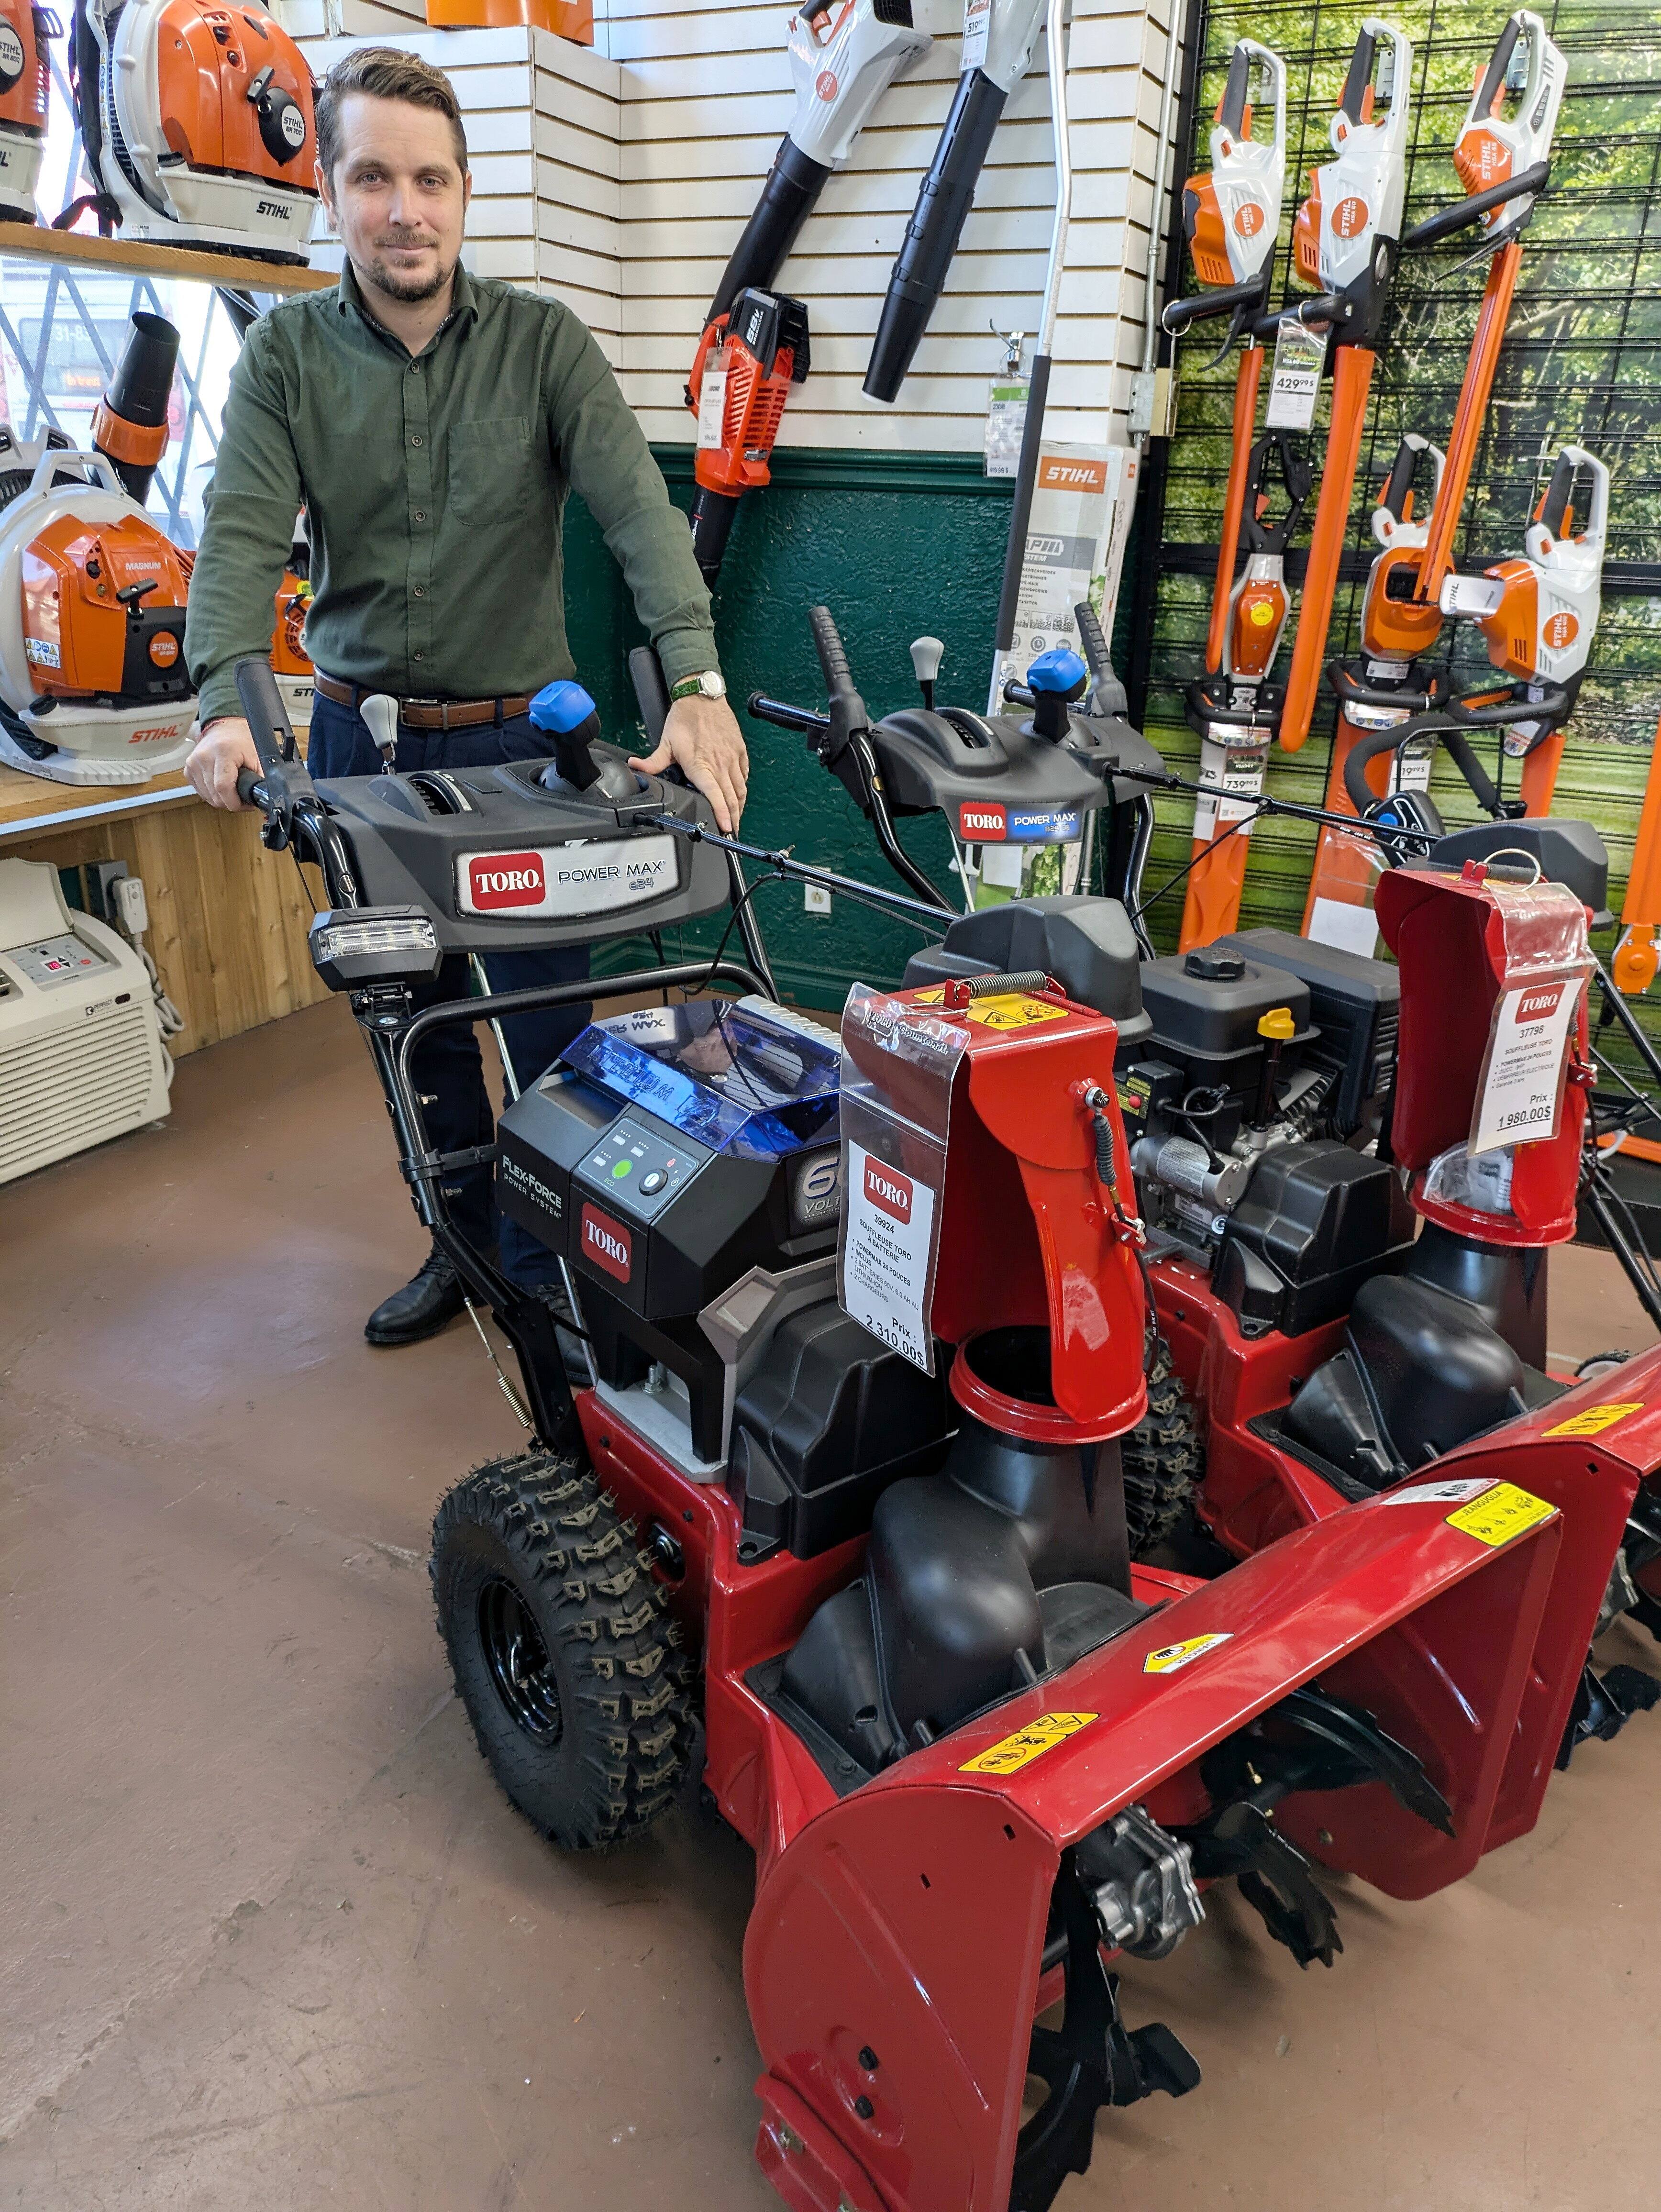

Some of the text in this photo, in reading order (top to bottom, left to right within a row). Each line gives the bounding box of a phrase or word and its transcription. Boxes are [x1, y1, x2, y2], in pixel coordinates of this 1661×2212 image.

[283, 116, 302, 129] STIHL
[1481, 140, 1491, 180] STIHL
[256, 201, 290, 220] STIHL
[1241, 207, 1252, 235] STIHL
[1341, 200, 1351, 236] STIHL
[1046, 466, 1099, 484] STIHL
[125, 562, 161, 570] MAGNUM
[1449, 583, 1460, 608] TIHL
[1553, 615, 1562, 647] STIHL
[152, 642, 175, 651] STIHL
[293, 688, 314, 697] STI
[128, 725, 179, 743] STIHL
[964, 814, 1003, 829] TORO
[1014, 813, 1075, 826] POWER MAX
[476, 869, 540, 894] TORO
[558, 861, 664, 884] POWER MAX
[629, 877, 654, 891] e24
[1521, 993, 1558, 1013] TORO
[1519, 1025, 1544, 1039] 37798
[1505, 1038, 1553, 1055] SOUFFLEUSE TORO
[587, 1045, 675, 1101] LITHIUM
[1530, 1093, 1548, 1104] Prix
[1507, 1106, 1551, 1125] 980.00$
[503, 1154, 562, 1209] FLEX-FORCE
[604, 1177, 615, 1186] ECO
[803, 1157, 843, 1200] 6
[867, 1169, 908, 1208] TORO
[504, 1173, 561, 1219] POWER SYSTEM
[875, 1214, 895, 1234] 39924
[586, 1219, 628, 1264] TORO
[860, 1219, 912, 1261] SOUFFLEUSE TORO
[868, 1234, 899, 1263] À BATTERIE
[855, 1249, 871, 1266] INCLUS
[856, 1240, 911, 1286] POWERMAX 24 POUCES
[854, 1265, 883, 1291] LITHIUM-ION
[858, 1260, 884, 1284] BATTERIES
[903, 1295, 911, 1305] AH
[911, 1301, 919, 1310] AU
[858, 1276, 889, 1303] CHARGEURS
[892, 1316, 911, 1339] Prix
[866, 1314, 924, 1366] 2 310.00$
